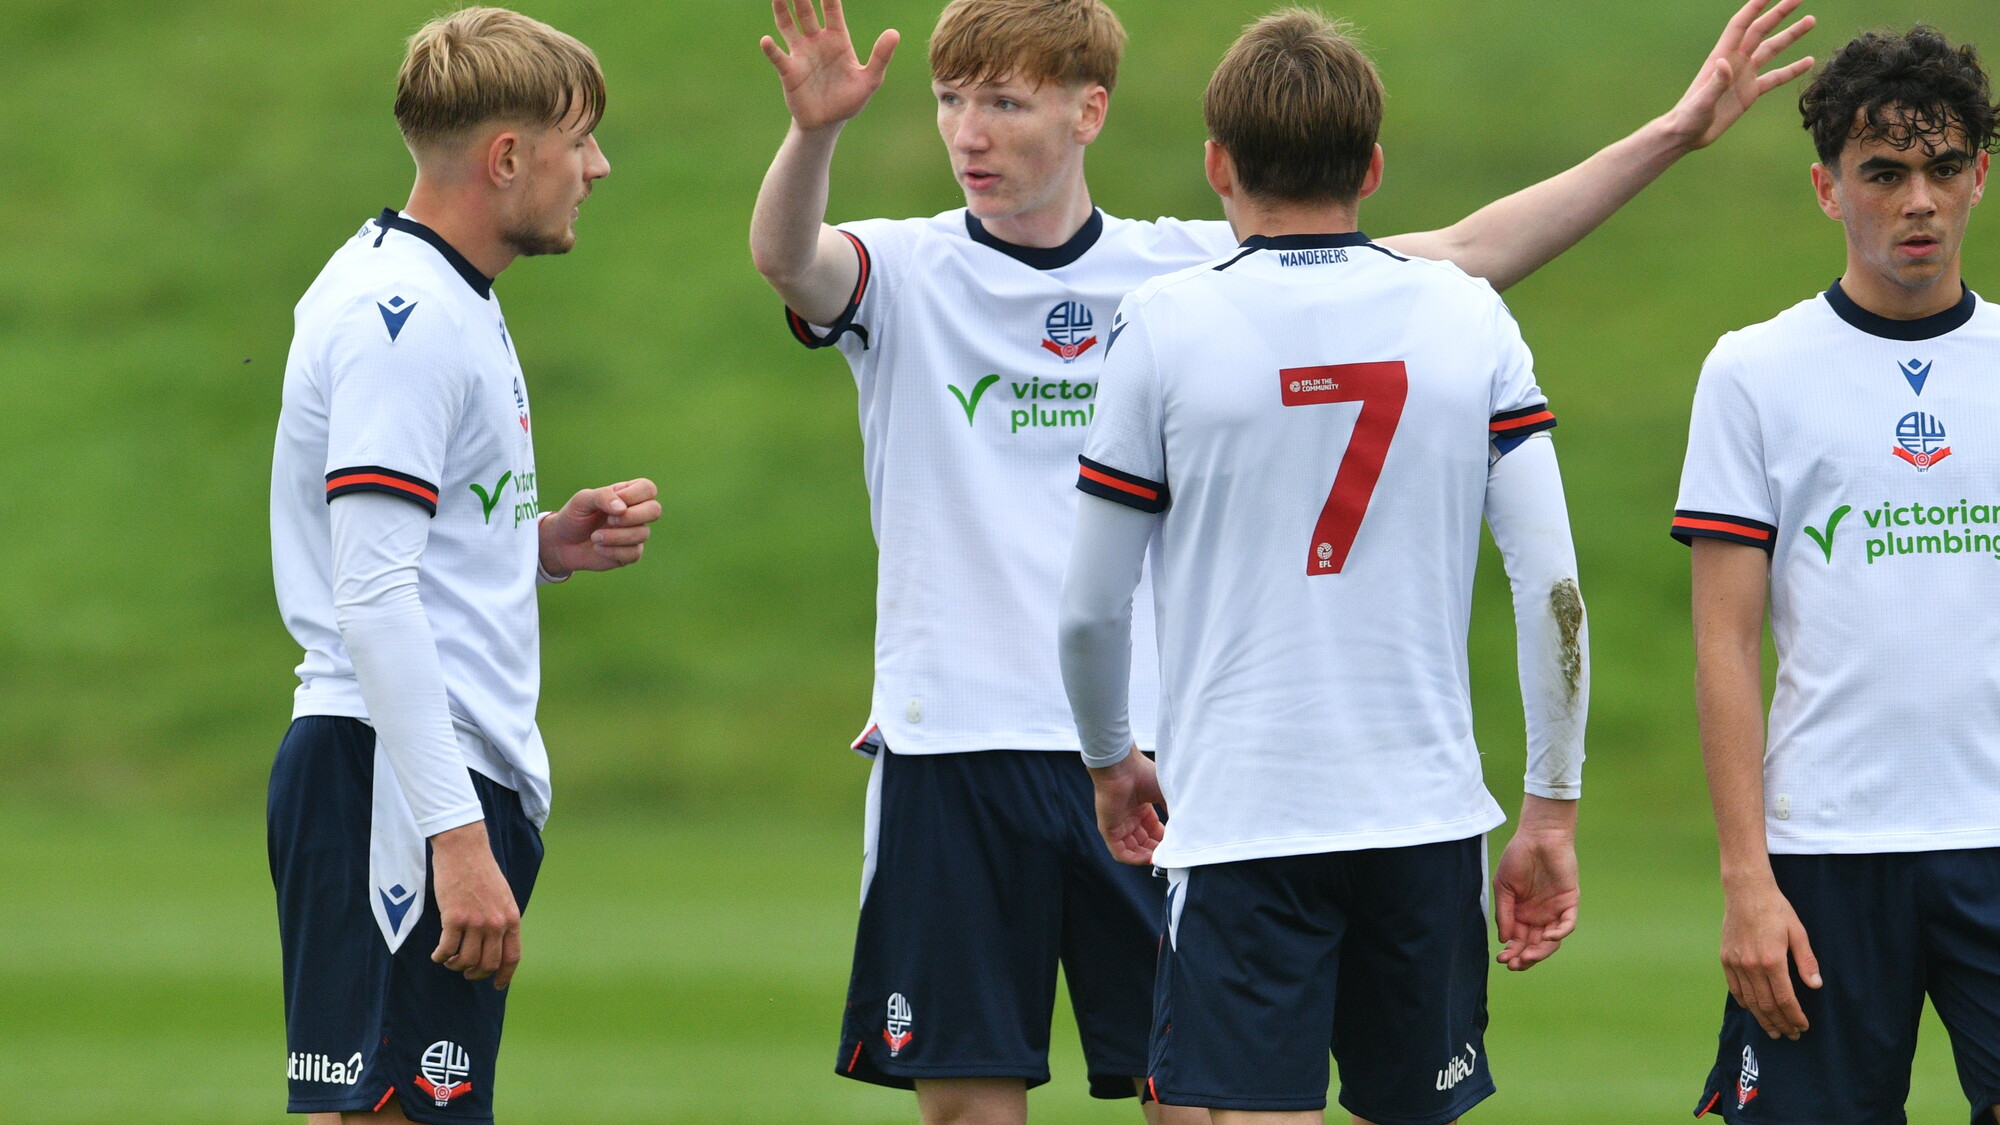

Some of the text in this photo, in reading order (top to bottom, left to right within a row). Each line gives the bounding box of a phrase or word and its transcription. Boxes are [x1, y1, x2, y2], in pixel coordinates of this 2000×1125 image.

[1279, 249, 1349, 267] WANDERERS
[1302, 383, 1340, 392] COMMUNITY
[1279, 360, 1409, 576] 7
[1319, 560, 1332, 569] EFL
